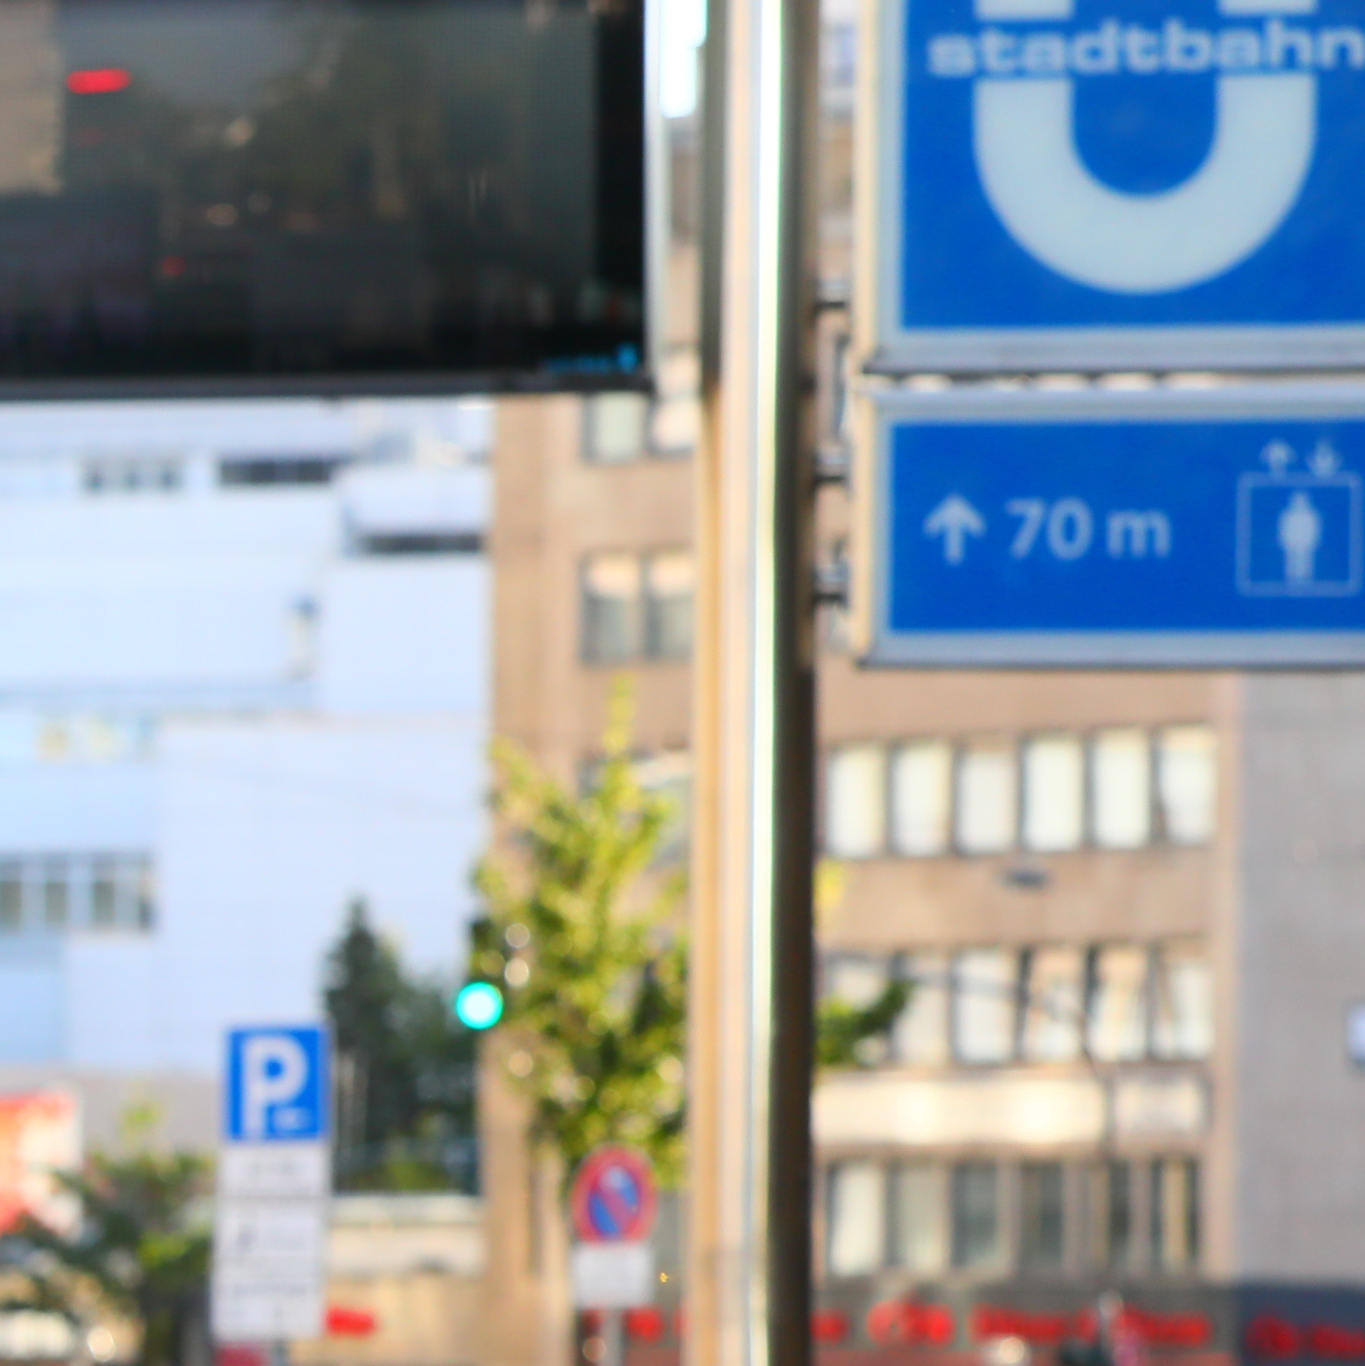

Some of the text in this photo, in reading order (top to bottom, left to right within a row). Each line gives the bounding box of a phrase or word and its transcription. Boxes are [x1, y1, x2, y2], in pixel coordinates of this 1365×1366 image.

[928, 17, 1365, 78] stadtbahn
[1005, 497, 1171, 559] 70 m
[241, 1033, 308, 1141] P
